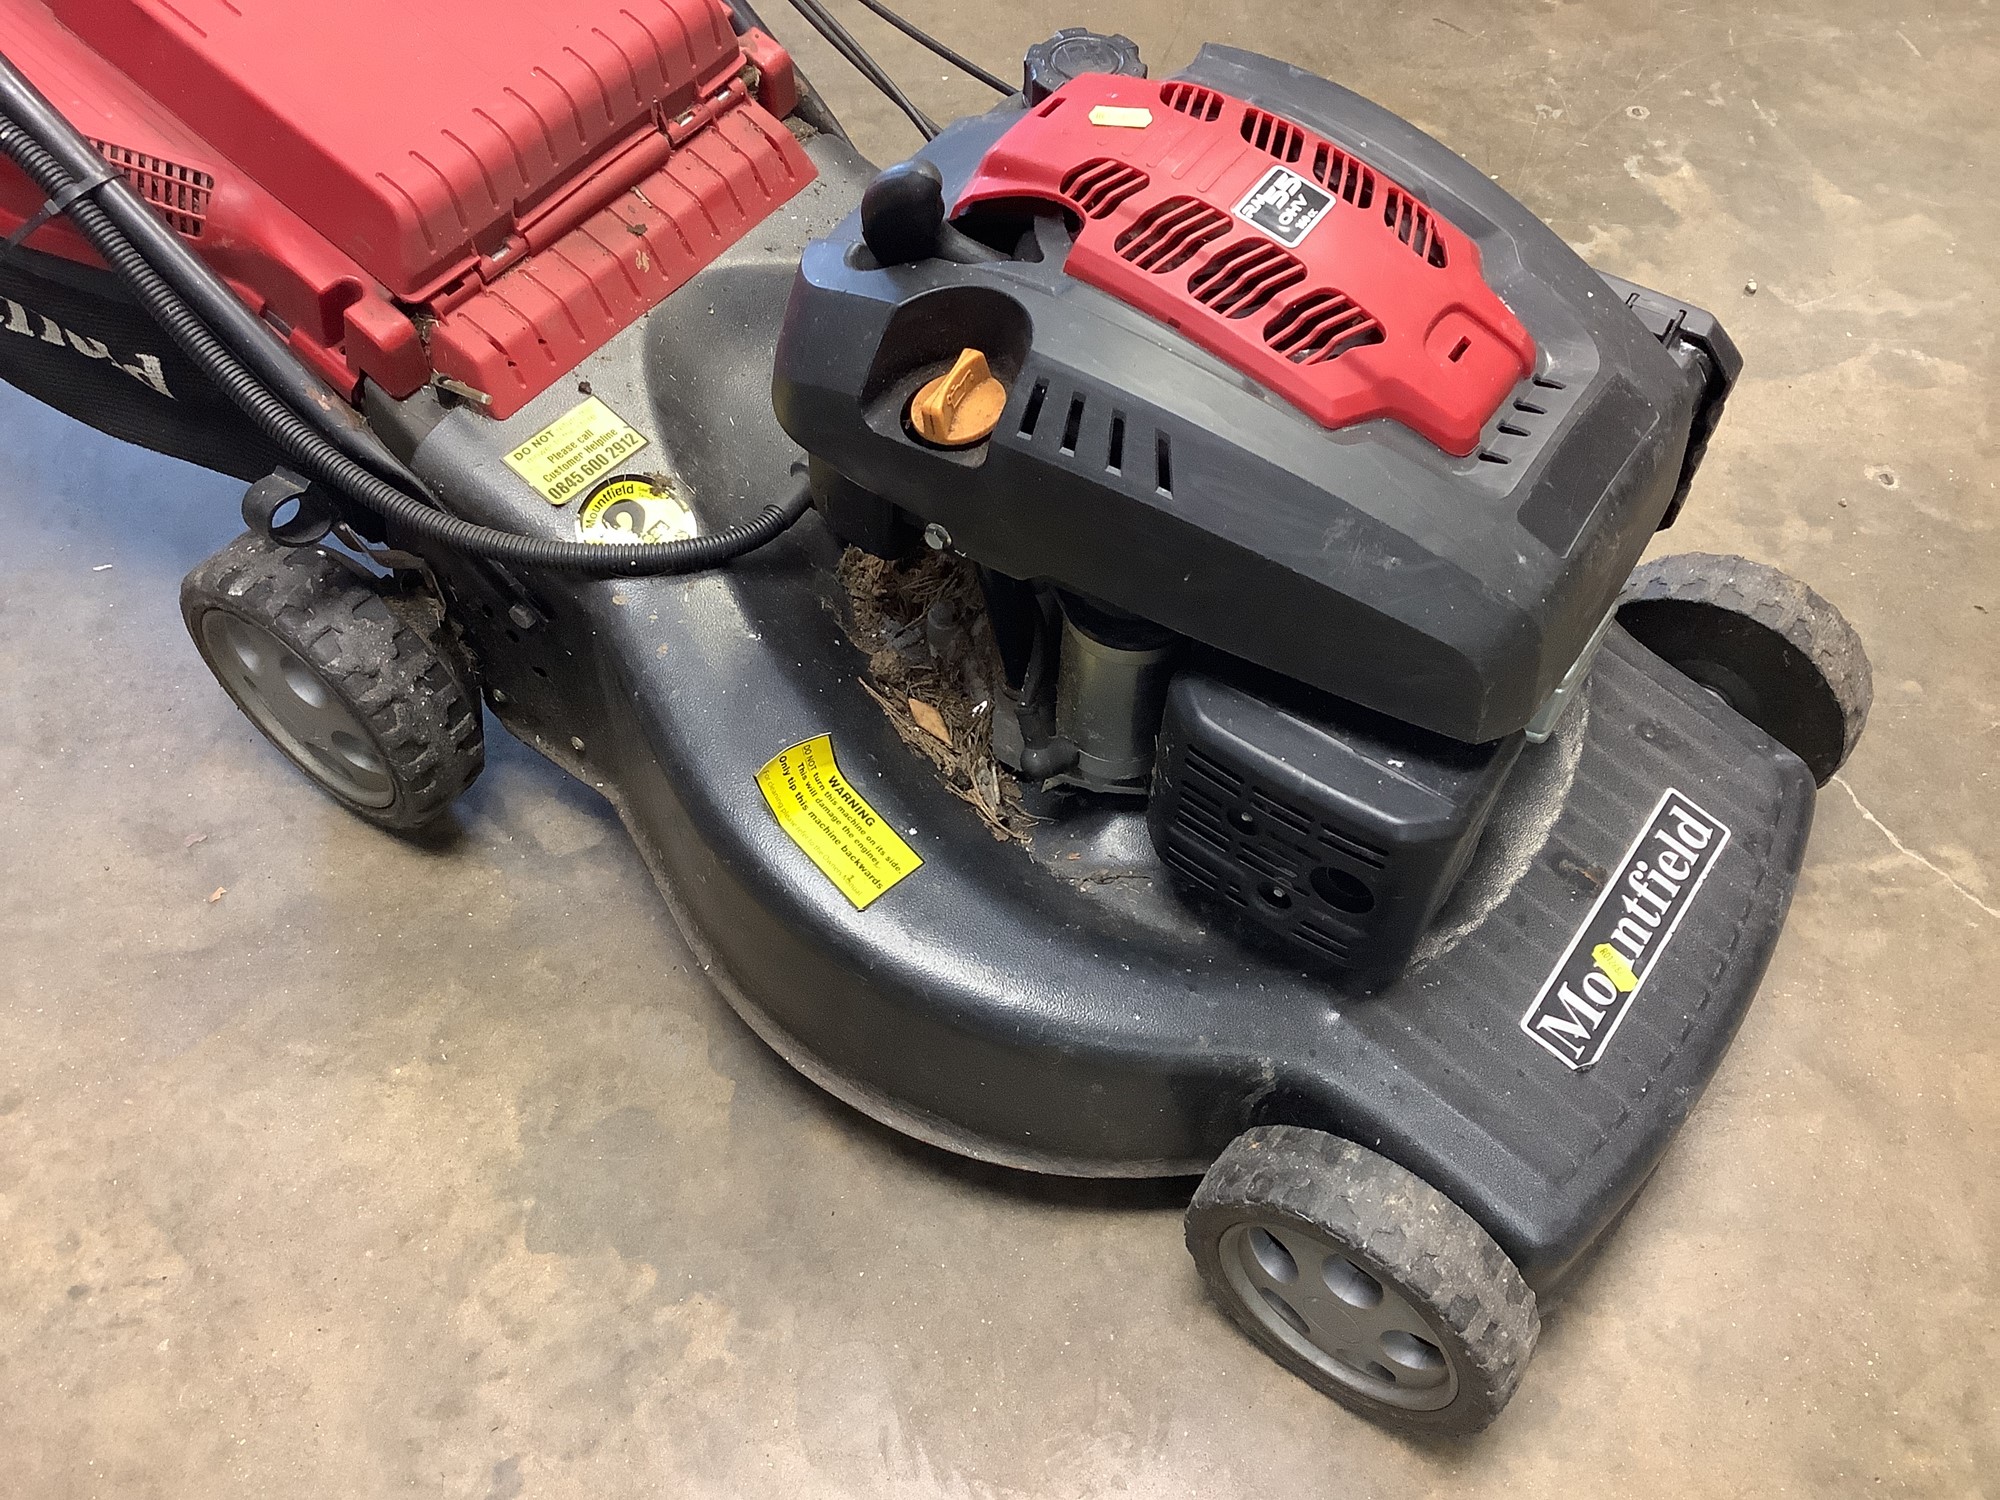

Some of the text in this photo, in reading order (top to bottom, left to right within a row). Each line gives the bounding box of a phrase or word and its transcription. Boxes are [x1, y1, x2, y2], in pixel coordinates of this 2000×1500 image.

[1279, 193, 1308, 226] OHV
[513, 430, 555, 462] DO NOT
[542, 452, 584, 483] Customer
[583, 428, 618, 454] Helpline
[546, 428, 595, 464] Please call
[547, 471, 585, 500] 0845
[581, 454, 610, 476] 600
[605, 432, 639, 459] 2912
[585, 484, 634, 529] Mountfield
[767, 780, 784, 809] cleaning
[797, 762, 808, 782] This
[805, 780, 818, 798] will
[815, 797, 842, 826] damage
[842, 825, 854, 839] the
[803, 744, 811, 756] DO
[807, 754, 817, 771] NOT
[813, 772, 825, 791] turn
[825, 791, 838, 806] this
[837, 805, 867, 836] machine
[865, 835, 876, 846] on
[875, 843, 886, 856] its
[828, 775, 876, 827] WARNING
[779, 755, 884, 890] Only tip this machine backwards
[1536, 805, 1713, 1060] Montfield
